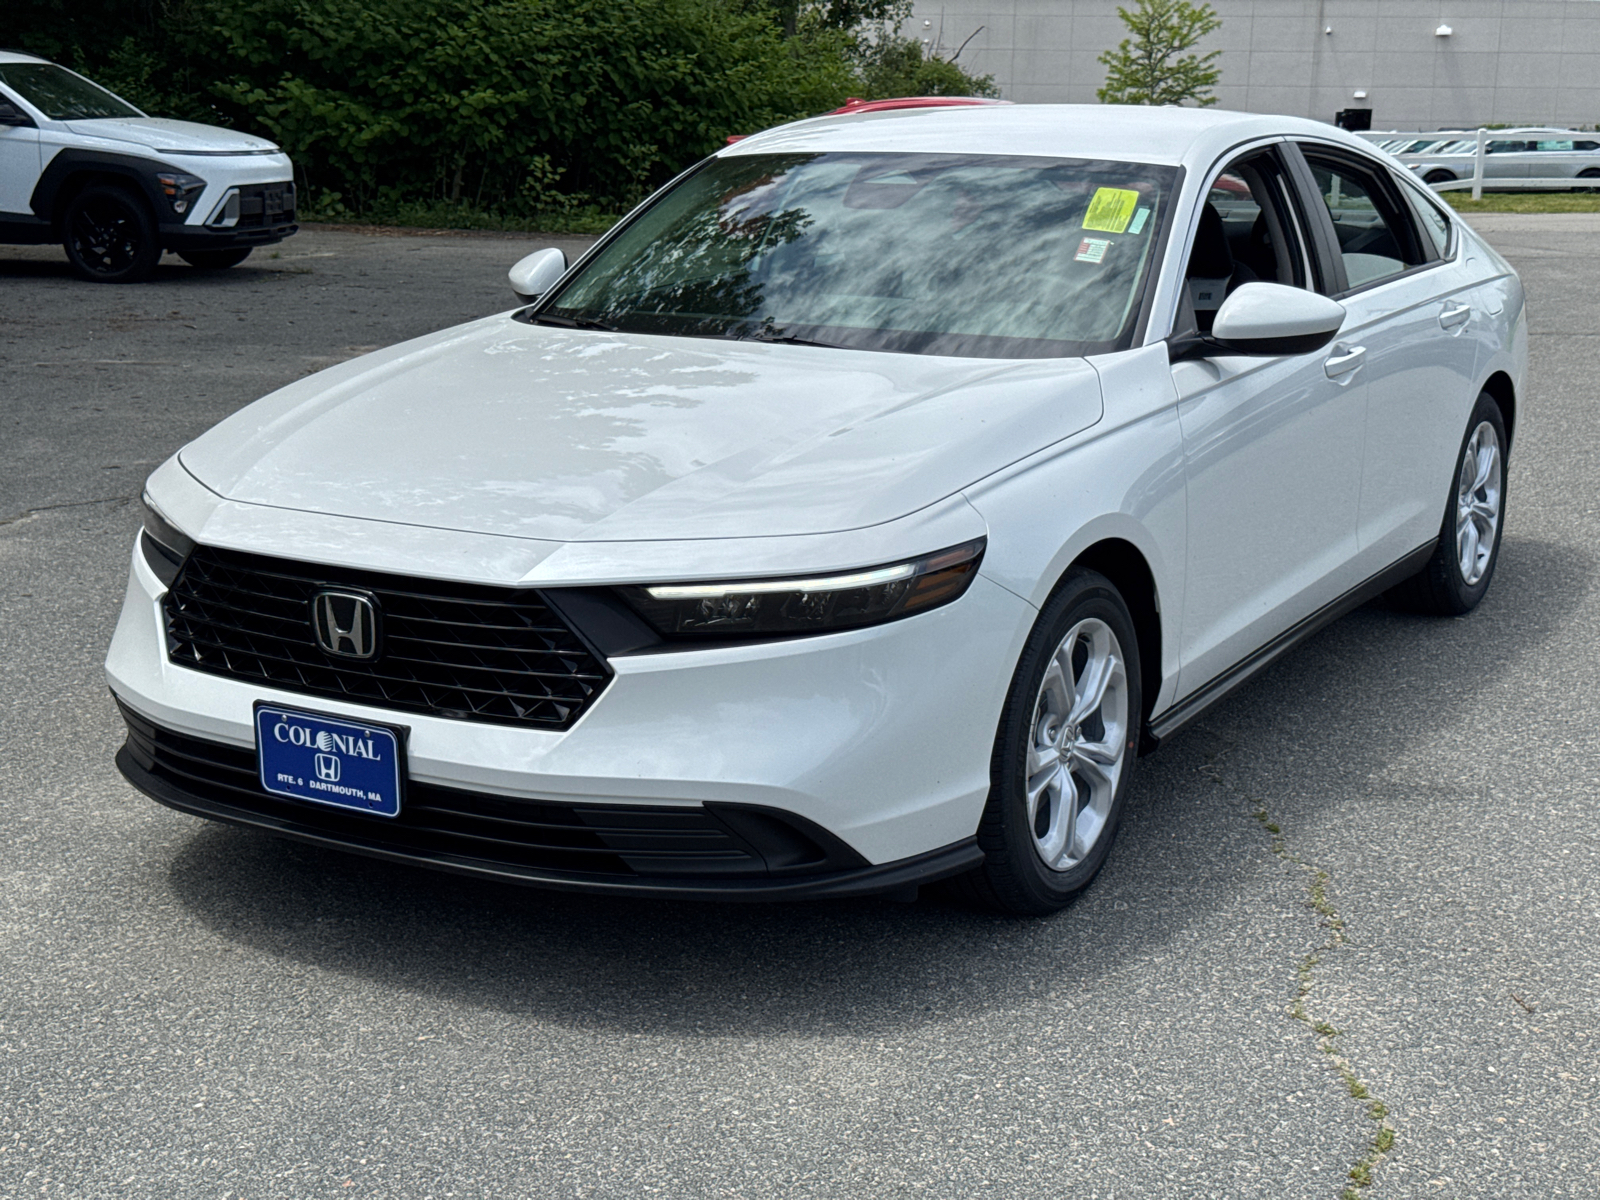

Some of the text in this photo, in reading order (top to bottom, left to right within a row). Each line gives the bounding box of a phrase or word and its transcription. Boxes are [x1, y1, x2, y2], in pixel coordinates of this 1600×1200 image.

[274, 722, 381, 761] COLONIAL
[277, 773, 382, 802] RTE. 6 DARTMOUTH, MA
